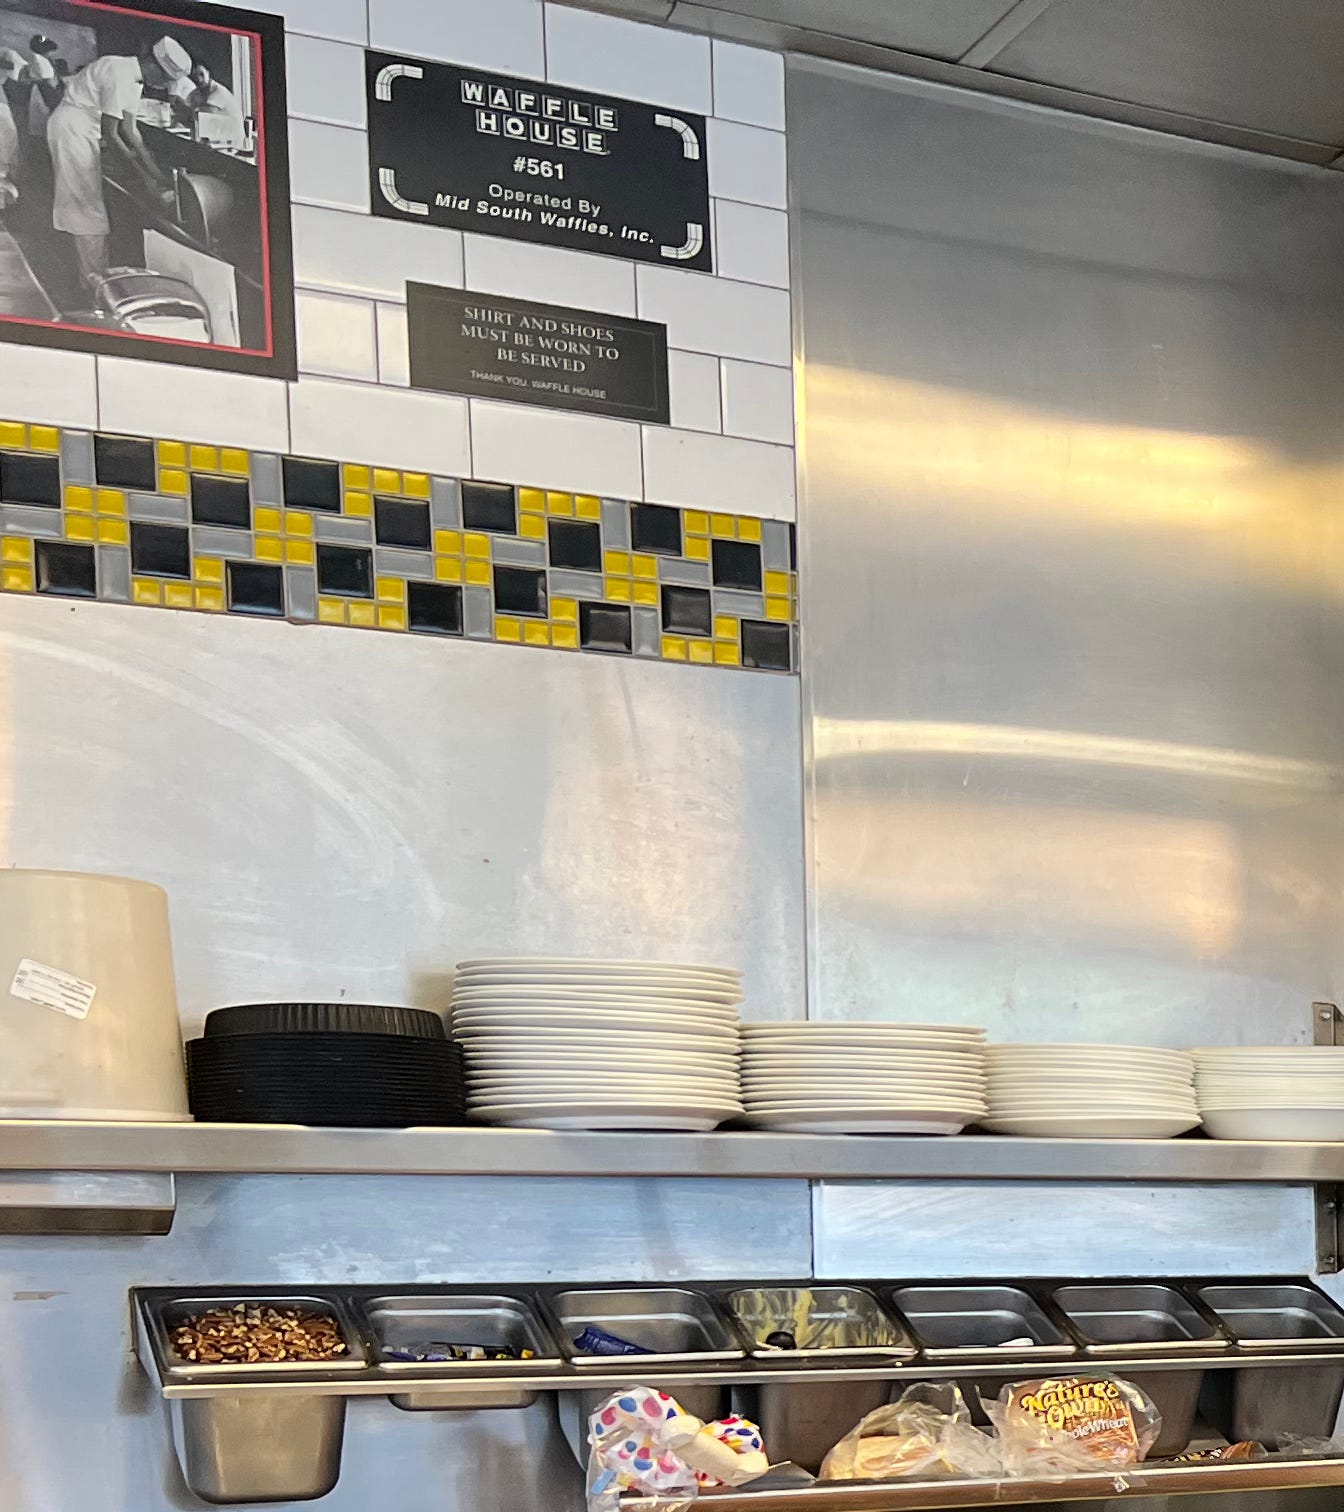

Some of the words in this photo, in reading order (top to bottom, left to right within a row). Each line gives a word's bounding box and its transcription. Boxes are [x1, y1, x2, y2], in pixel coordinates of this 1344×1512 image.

[463, 80, 617, 131] WAFFLE
[477, 110, 609, 155] HOUSE
[513, 156, 565, 180] #561
[434, 192, 470, 211] Mid
[476, 201, 533, 223] South
[540, 211, 615, 239] Waffles,
[620, 225, 656, 245] Inc.
[488, 183, 573, 210] Operated
[577, 199, 602, 219] By
[460, 323, 510, 344] MUST
[513, 331, 536, 348] BE
[538, 335, 592, 357] WORN
[594, 345, 620, 361] TO
[463, 306, 515, 326] SHIRT
[519, 315, 558, 333] AND
[561, 321, 615, 343] SHOES
[496, 347, 519, 363] BE
[521, 351, 587, 374] SERVED
[469, 369, 504, 383] THANK
[532, 379, 571, 395] WAFFLE
[572, 385, 607, 400] HOUSE
[1019, 1379, 1120, 1413] Nature's
[1046, 1399, 1111, 1430] Own
